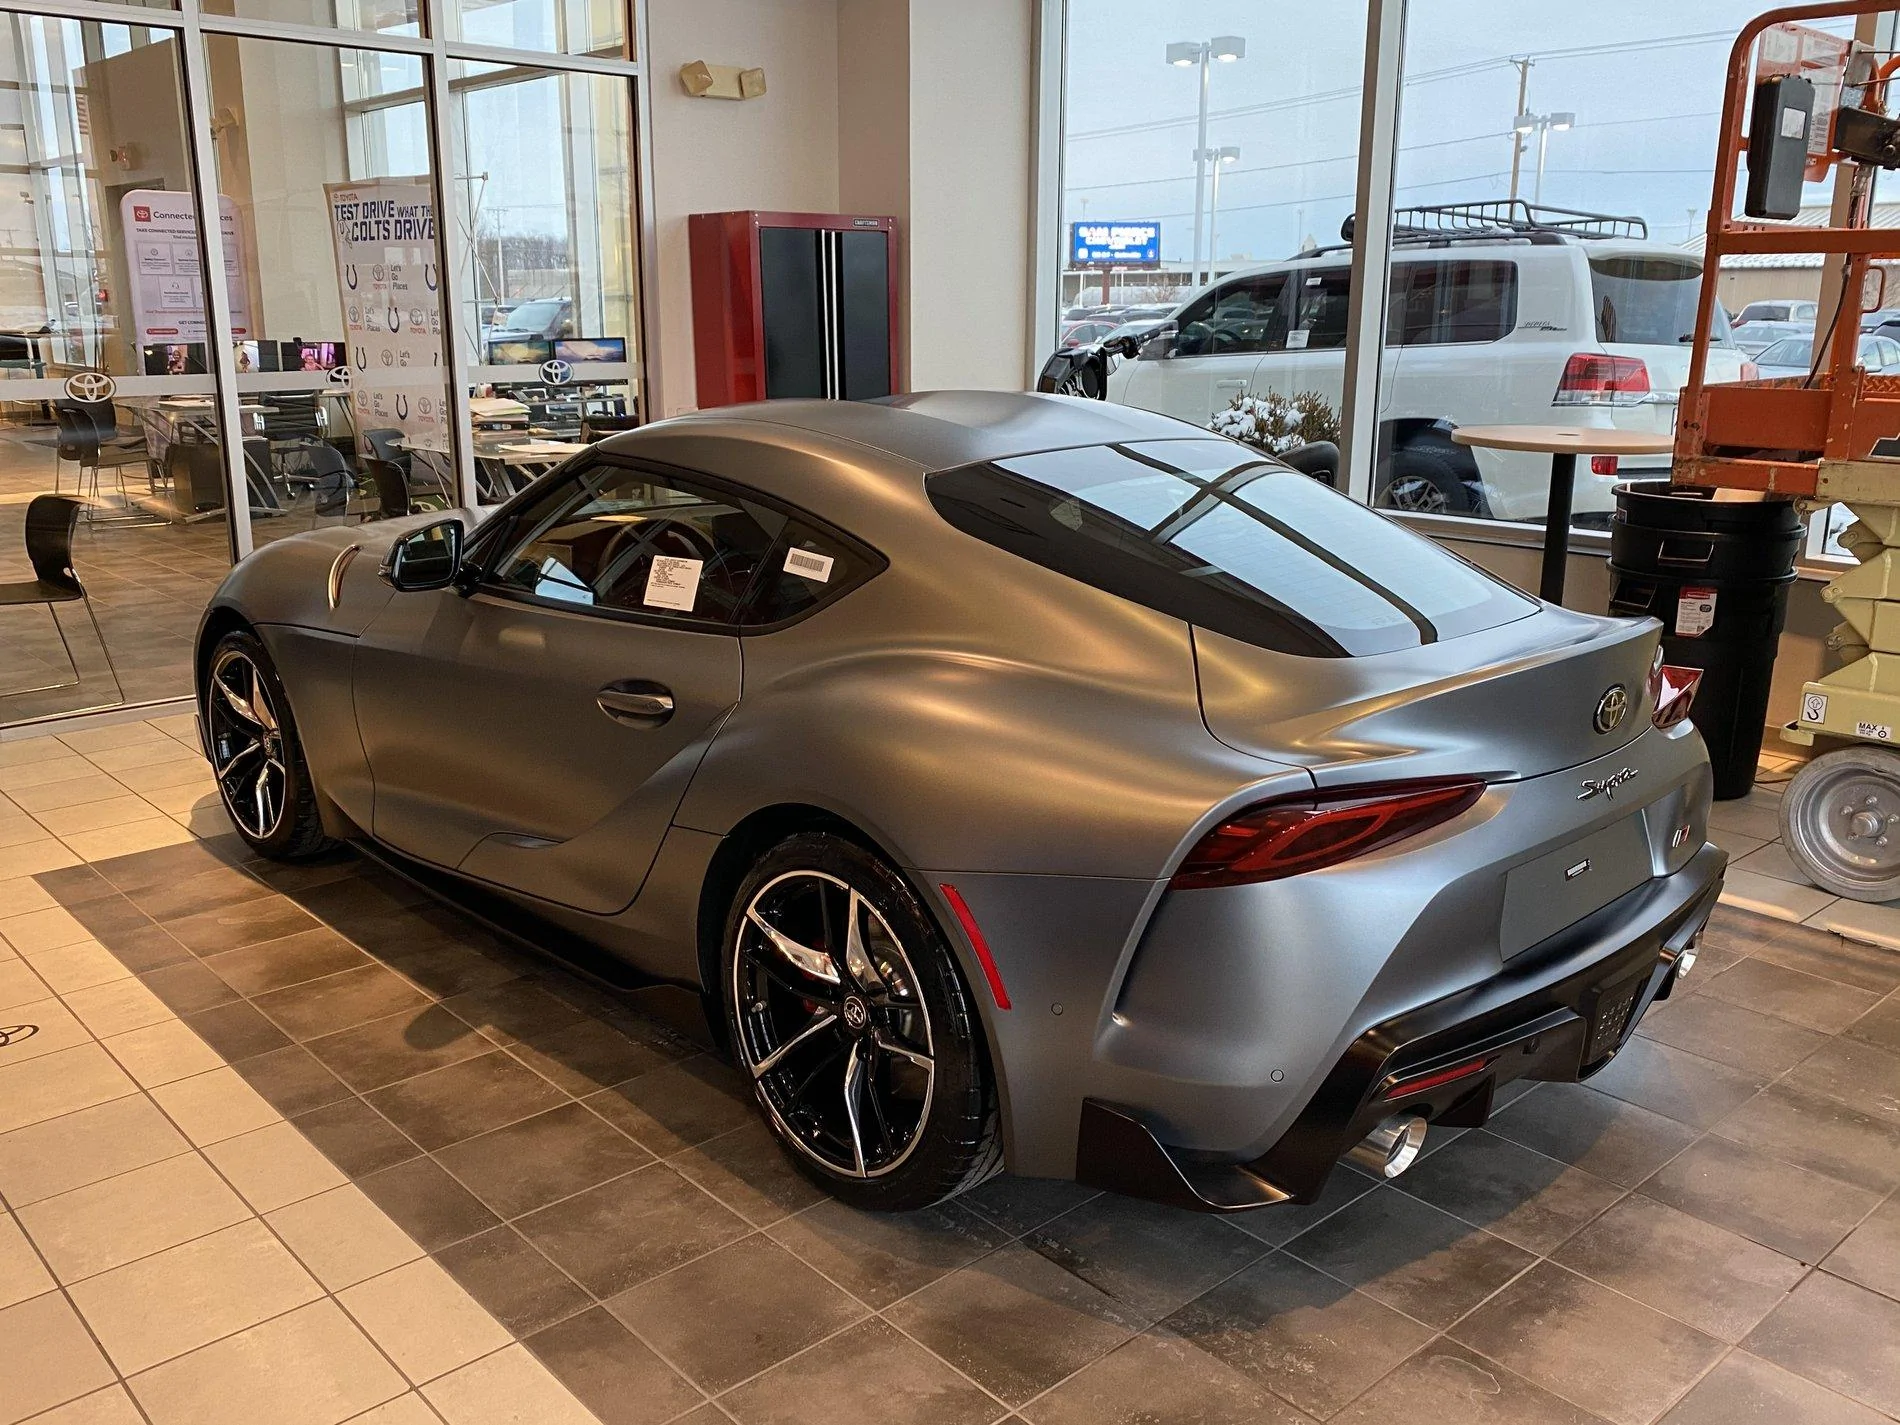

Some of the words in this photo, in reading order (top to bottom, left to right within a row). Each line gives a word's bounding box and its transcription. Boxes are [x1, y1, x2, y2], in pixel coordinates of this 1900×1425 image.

[334, 203, 360, 221] TEST
[362, 200, 395, 219] DRIVE
[397, 206, 419, 218] WHAT
[420, 205, 432, 217] TH
[153, 211, 196, 221] Connecte
[351, 220, 390, 241] COLTS
[394, 218, 434, 240] DRIVE
[391, 273, 399, 281] Go
[393, 282, 408, 291] Places
[1858, 722, 1878, 731] MAX
[1577, 768, 1638, 801] Supra
